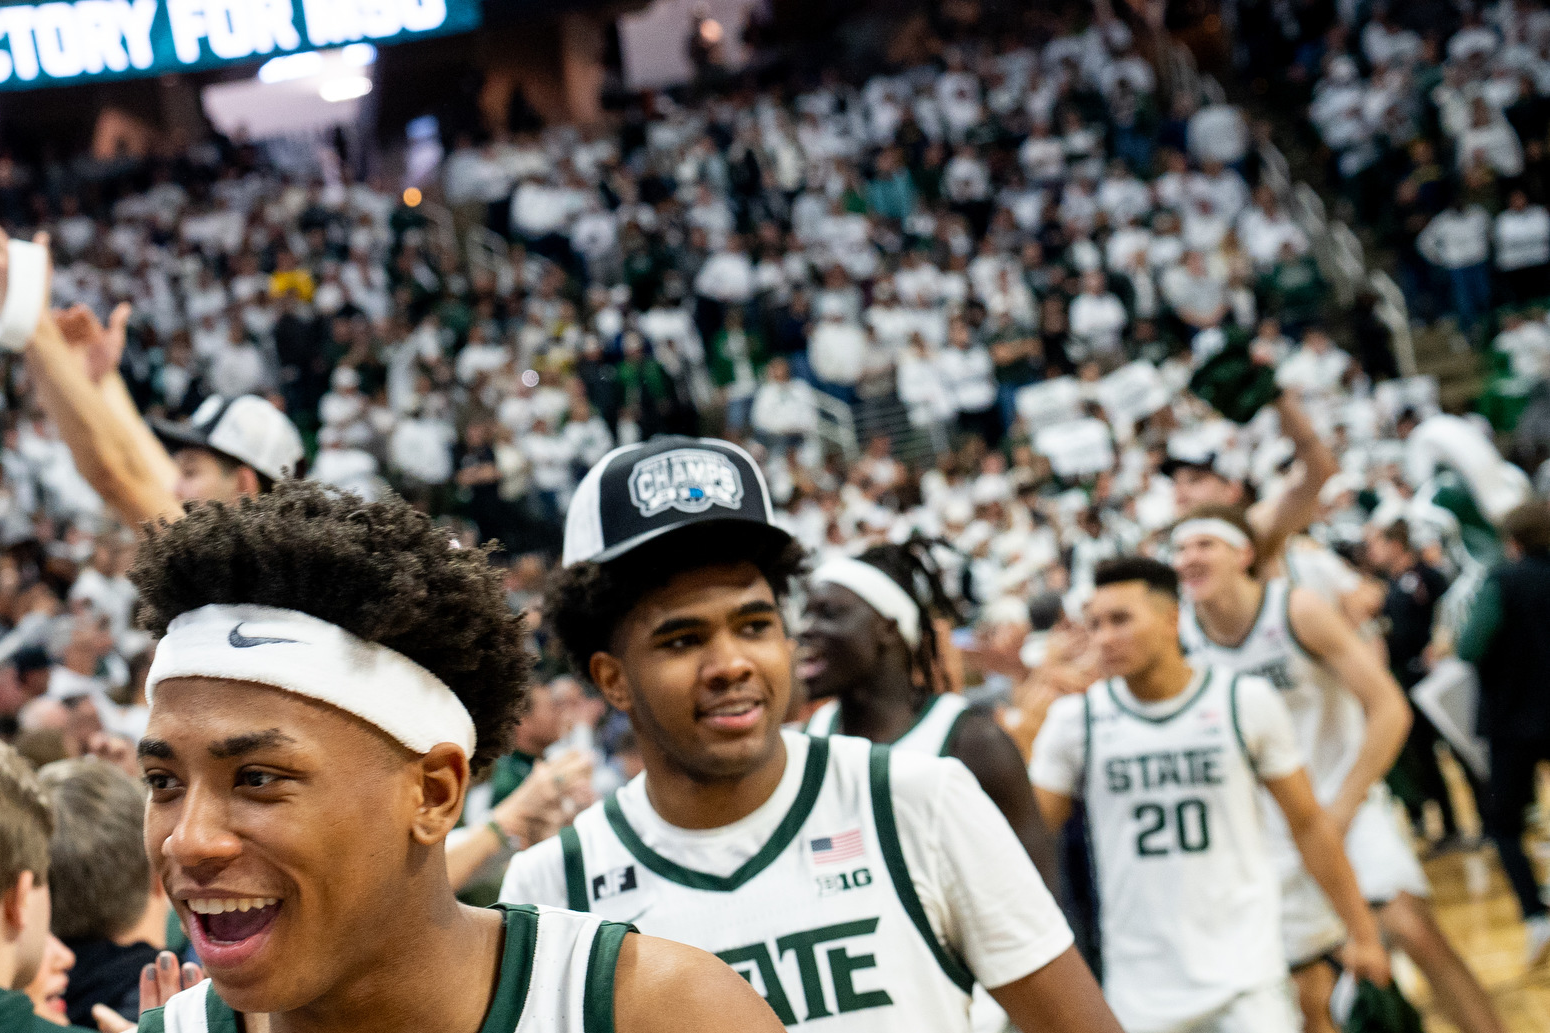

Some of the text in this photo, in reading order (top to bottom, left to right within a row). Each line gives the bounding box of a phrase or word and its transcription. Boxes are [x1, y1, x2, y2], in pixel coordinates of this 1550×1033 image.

[165, 0, 300, 64] FOR
[636, 458, 737, 502] CHAMPS
[1105, 746, 1225, 794] STATE
[1134, 798, 1210, 857] 20
[715, 916, 895, 1027] ATE
